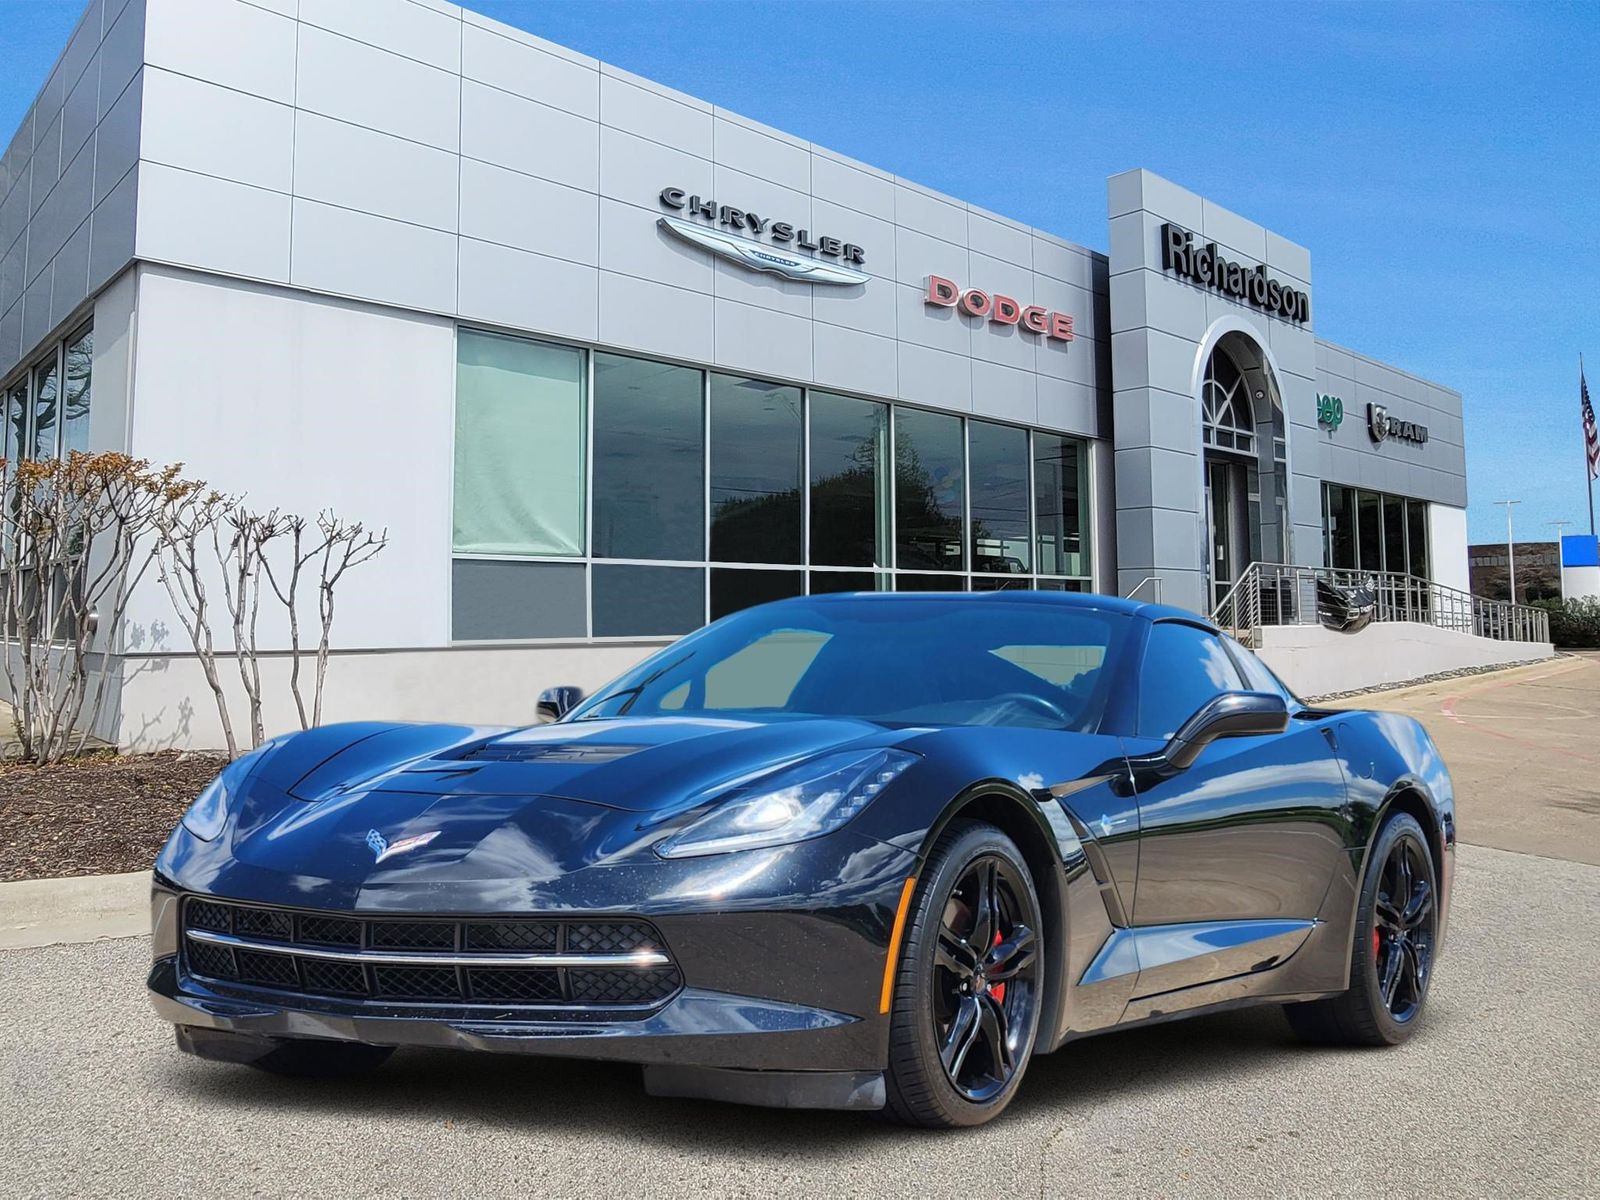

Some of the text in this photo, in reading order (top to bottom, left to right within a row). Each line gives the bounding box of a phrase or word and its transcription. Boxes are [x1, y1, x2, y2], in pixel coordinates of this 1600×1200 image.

[659, 186, 866, 264] CHRYSLER
[923, 274, 1073, 342] DODGE
[1161, 223, 1310, 323] Richardson
[1387, 416, 1428, 443] RAM
